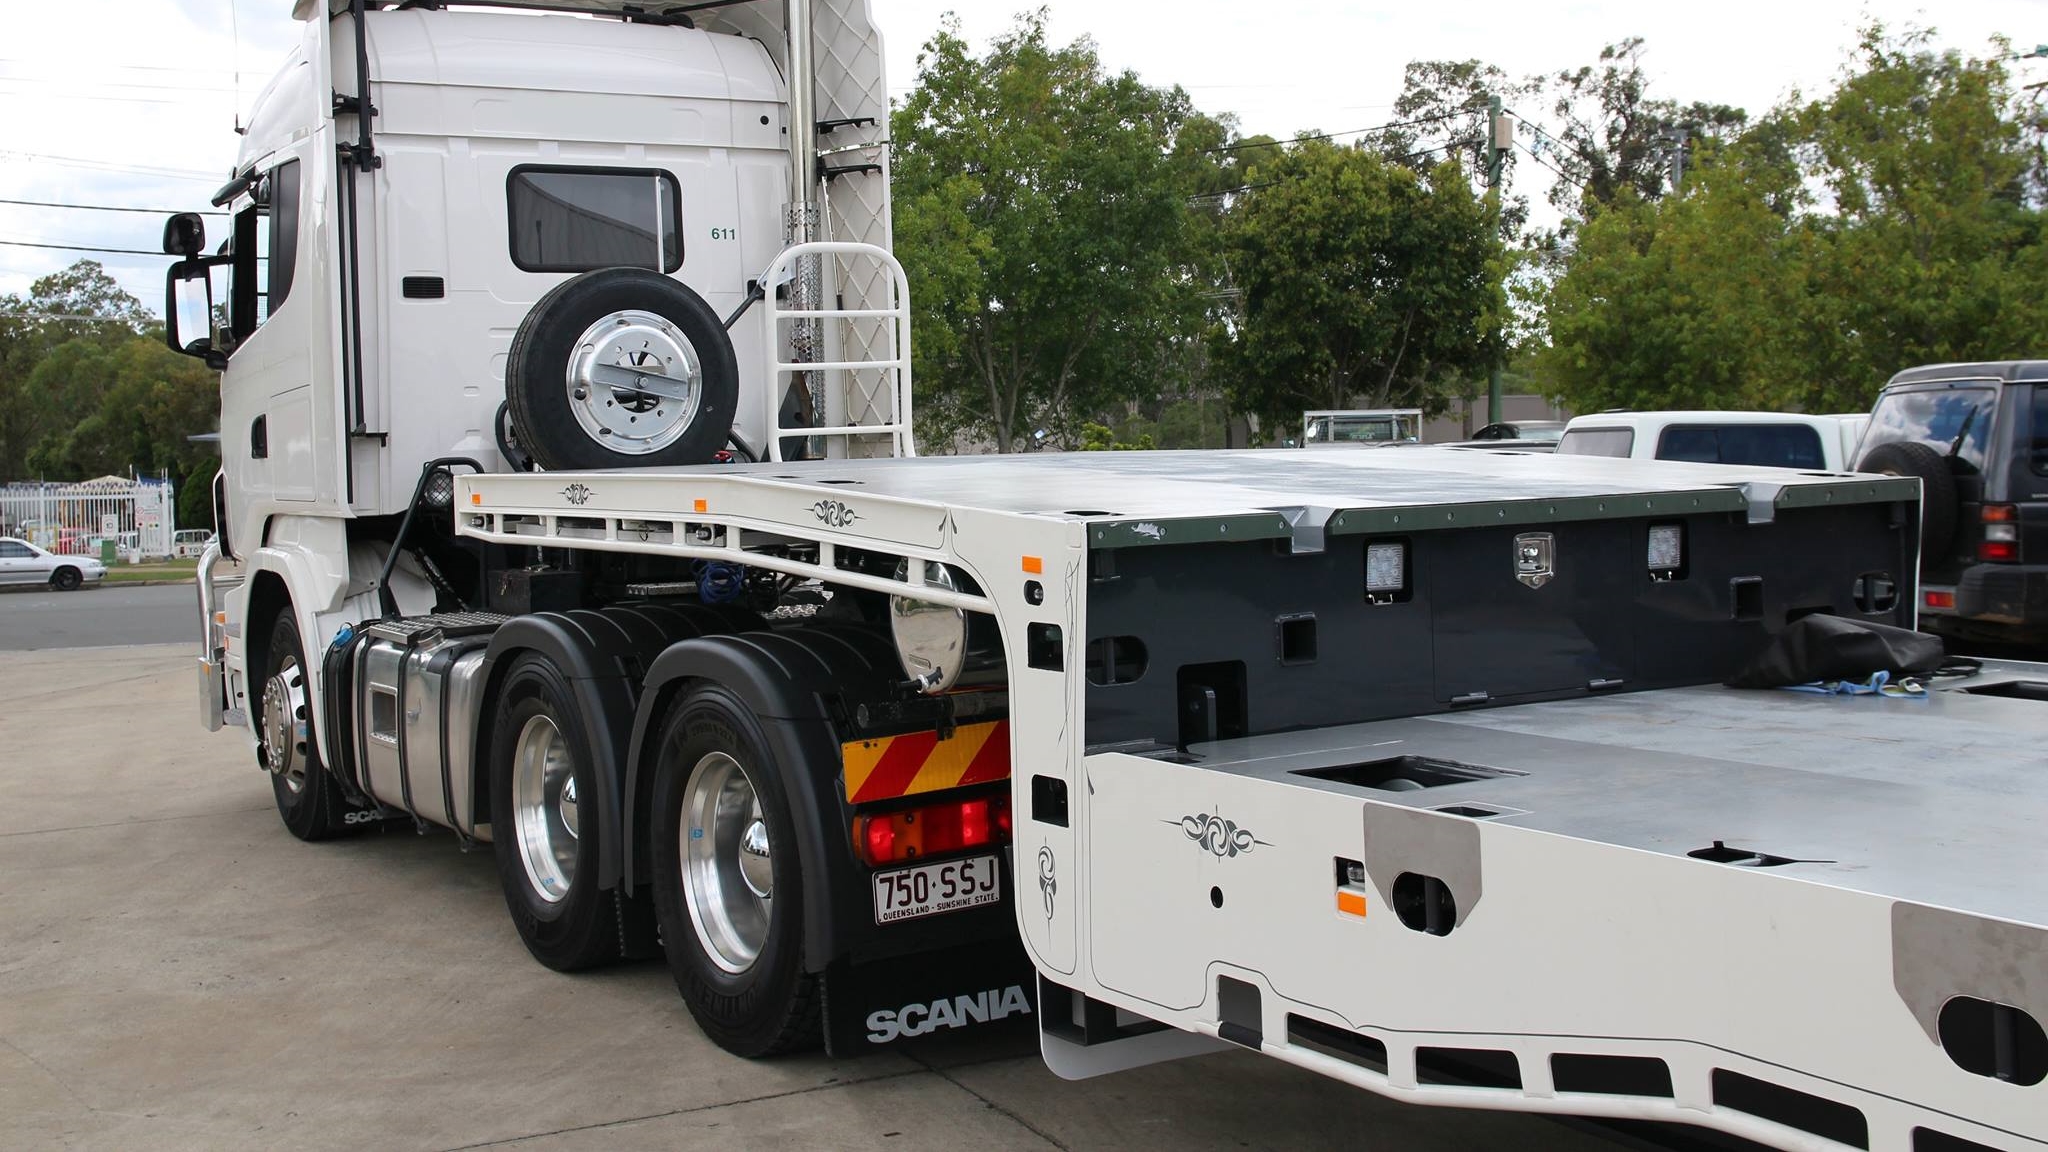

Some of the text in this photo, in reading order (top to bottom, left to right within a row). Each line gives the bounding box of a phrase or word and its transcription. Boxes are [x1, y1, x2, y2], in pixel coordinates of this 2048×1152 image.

[711, 227, 735, 240] 611
[883, 904, 930, 921] QUEENSLAND
[936, 897, 972, 911] SUNSHINE
[866, 984, 1032, 1044] SCANIA
